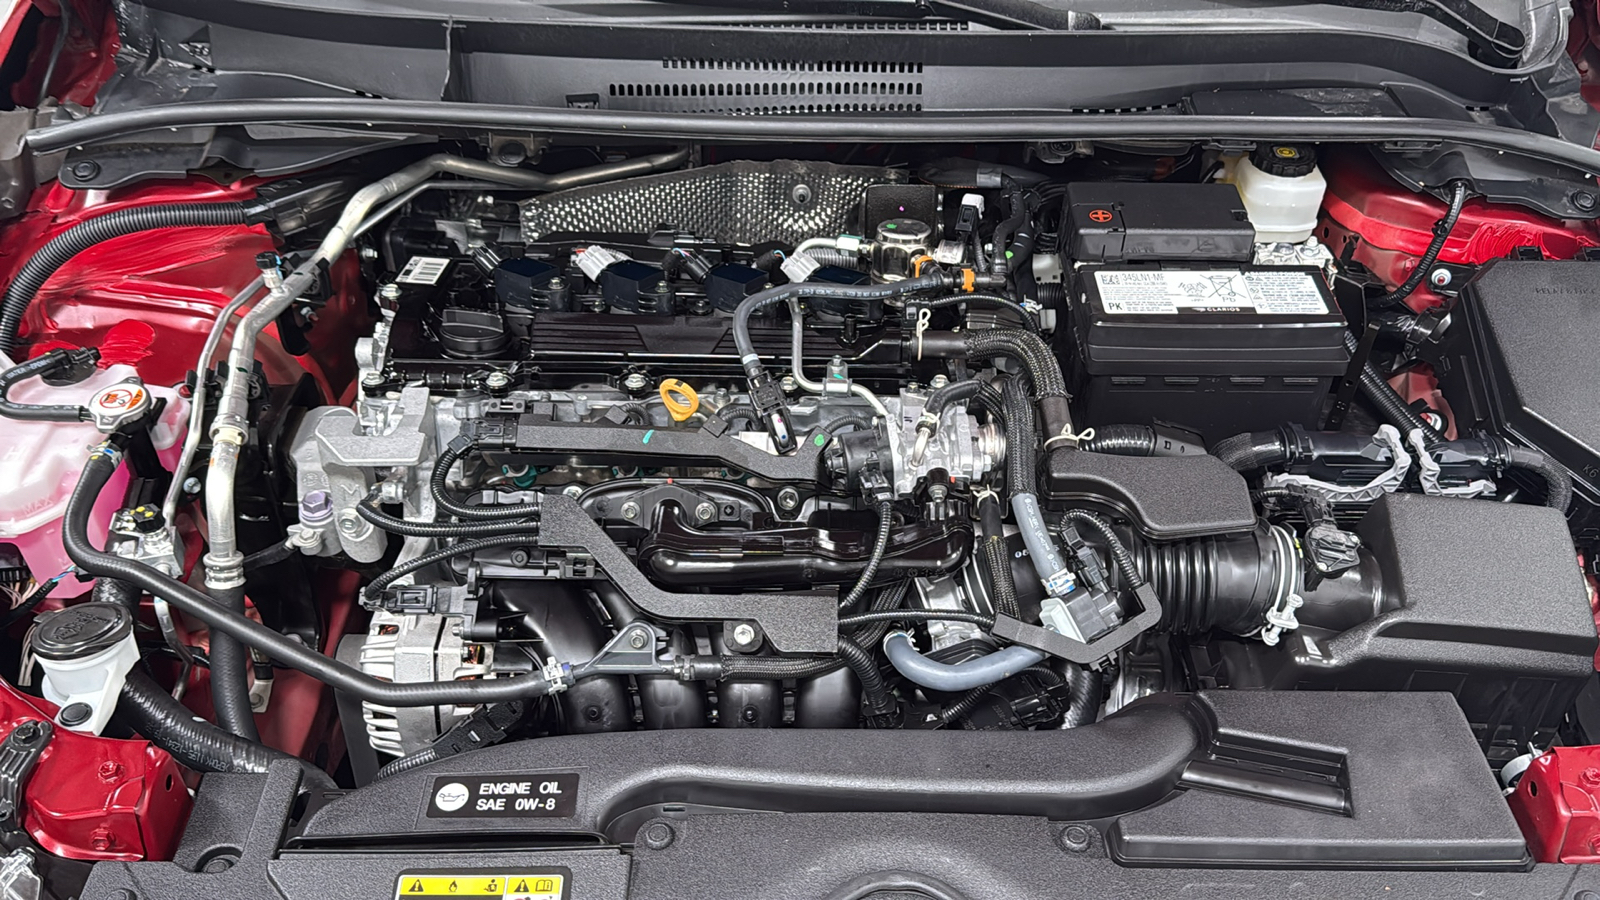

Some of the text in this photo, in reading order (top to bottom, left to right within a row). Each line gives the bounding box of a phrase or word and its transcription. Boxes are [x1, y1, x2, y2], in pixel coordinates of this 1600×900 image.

[1108, 302, 1123, 311] PK
[25, 498, 53, 515] MAX
[479, 781, 562, 794] ENGINE OIL
[475, 798, 556, 811] SAE 0W-8
